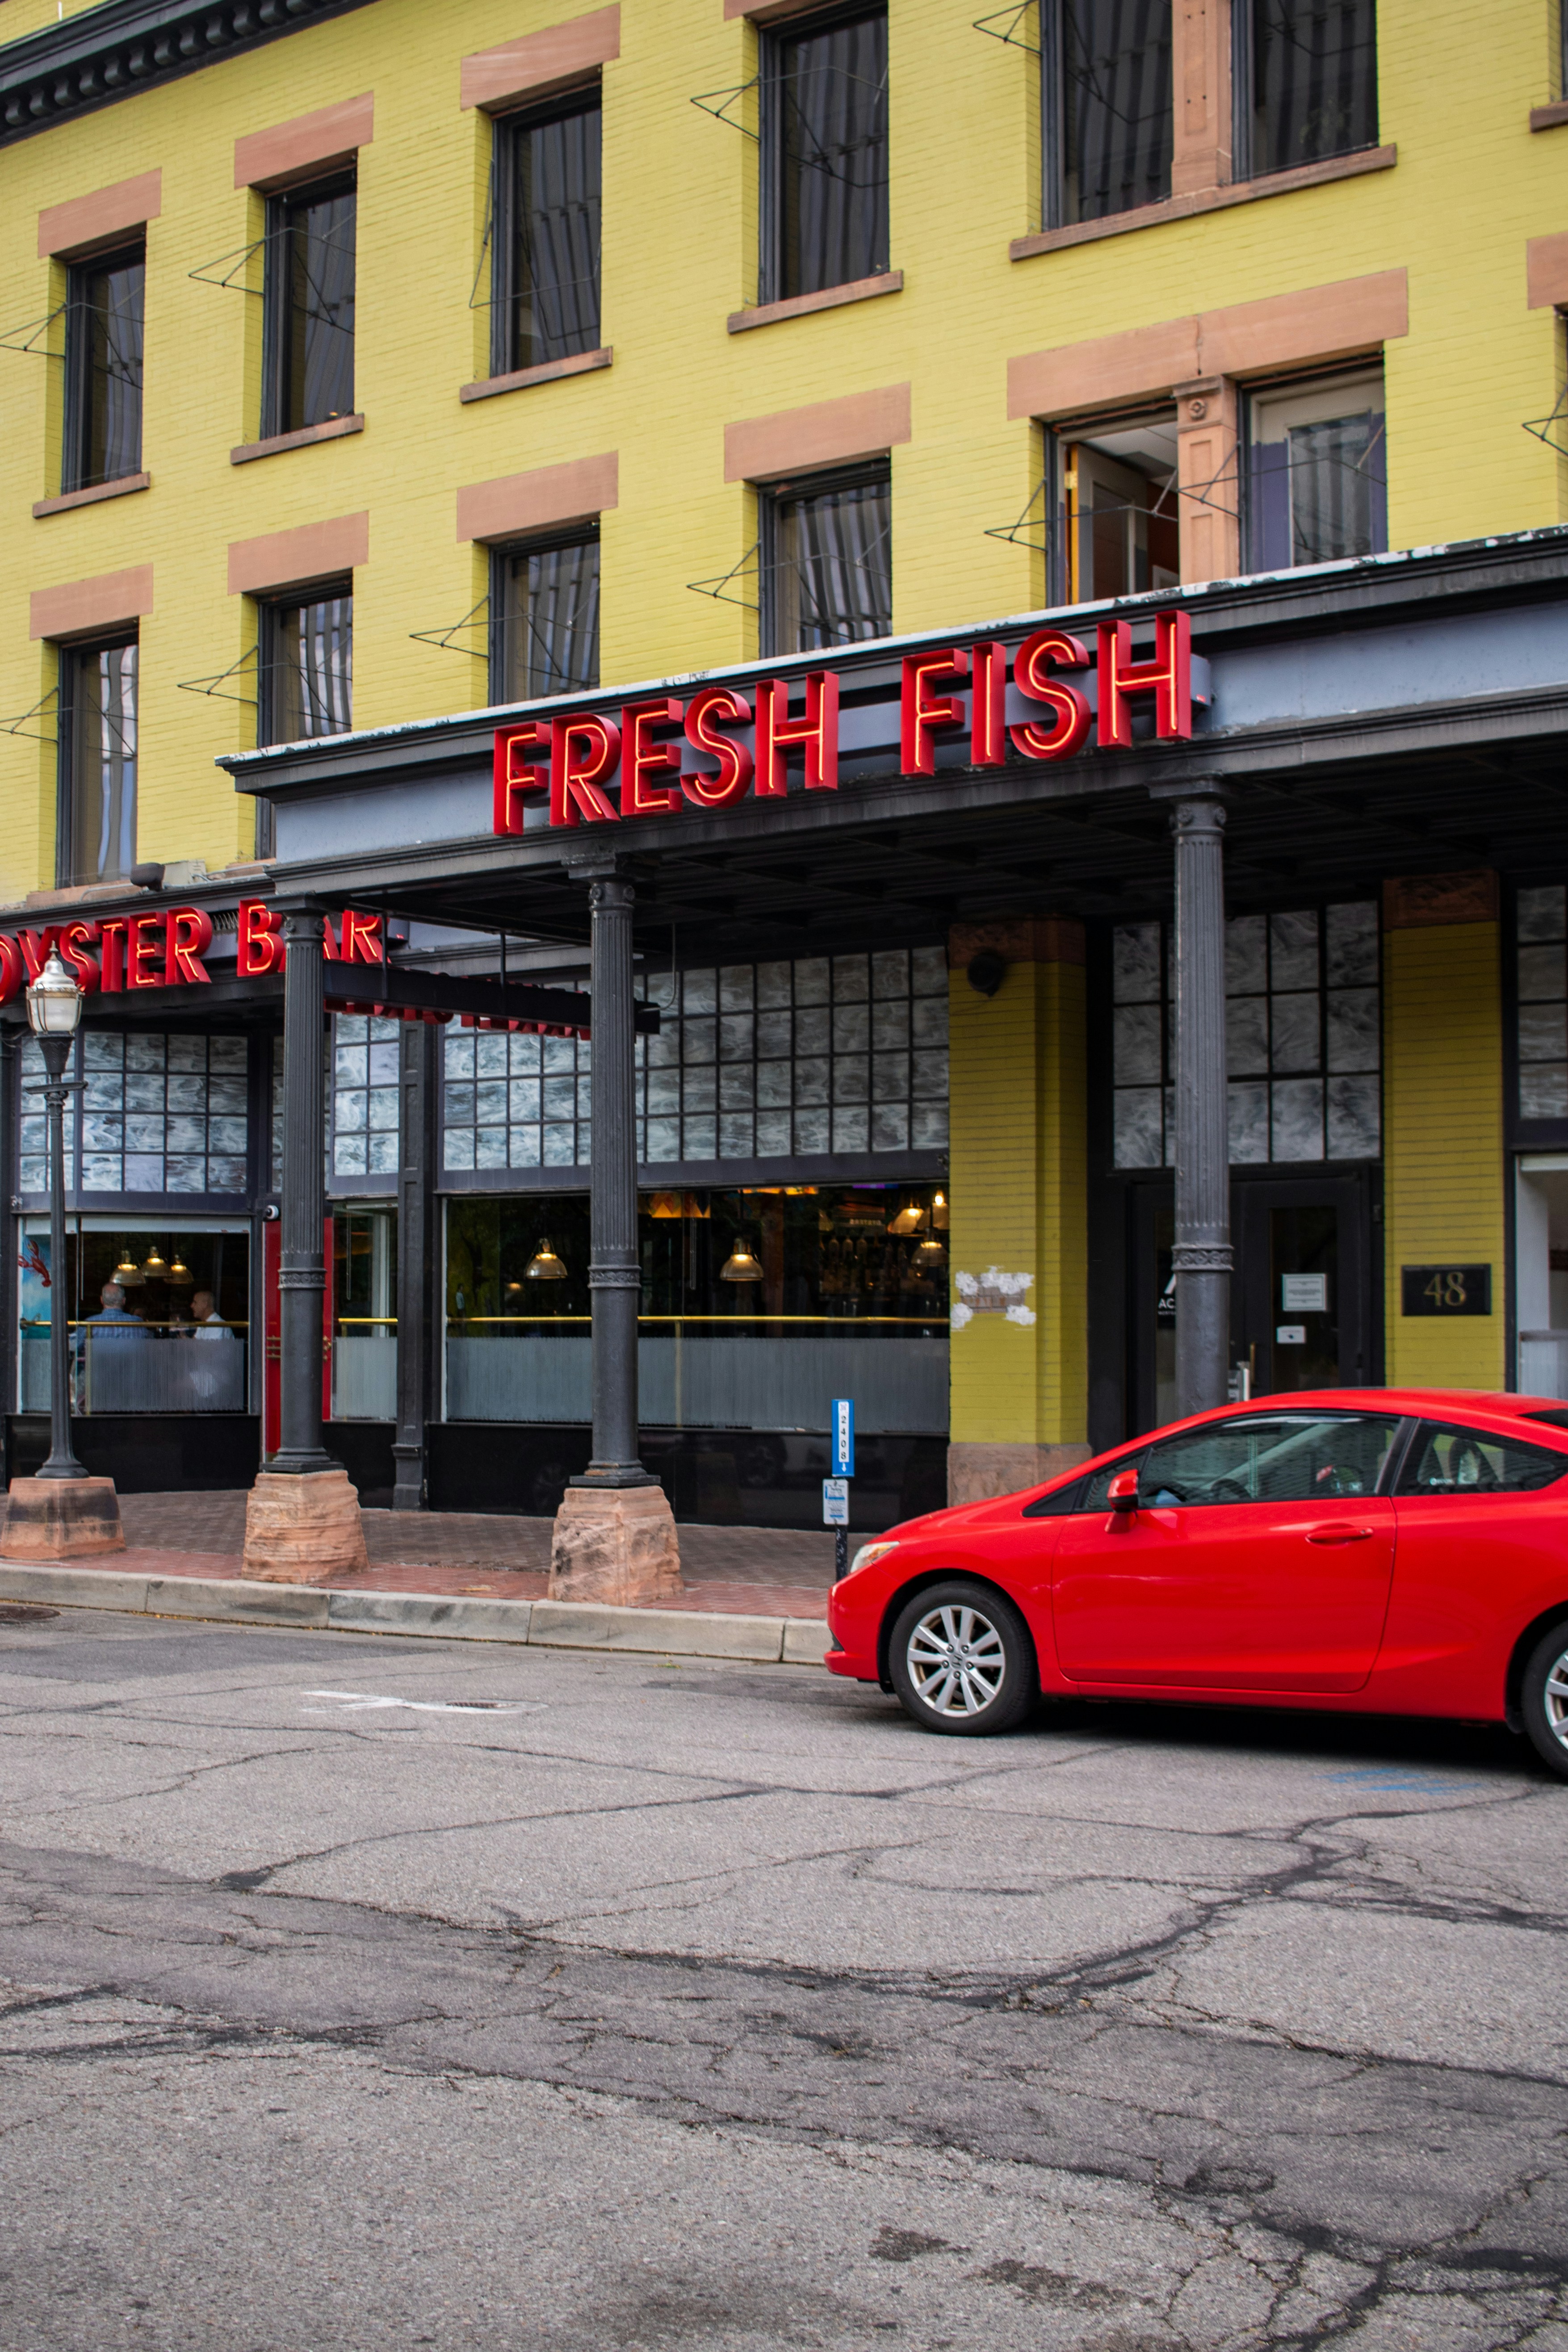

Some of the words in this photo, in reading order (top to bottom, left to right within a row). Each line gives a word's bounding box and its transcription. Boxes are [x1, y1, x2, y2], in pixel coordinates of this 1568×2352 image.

[494, 671, 839, 838] FRESH
[900, 609, 1192, 778] FISH
[1424, 1271, 1467, 1307] 48
